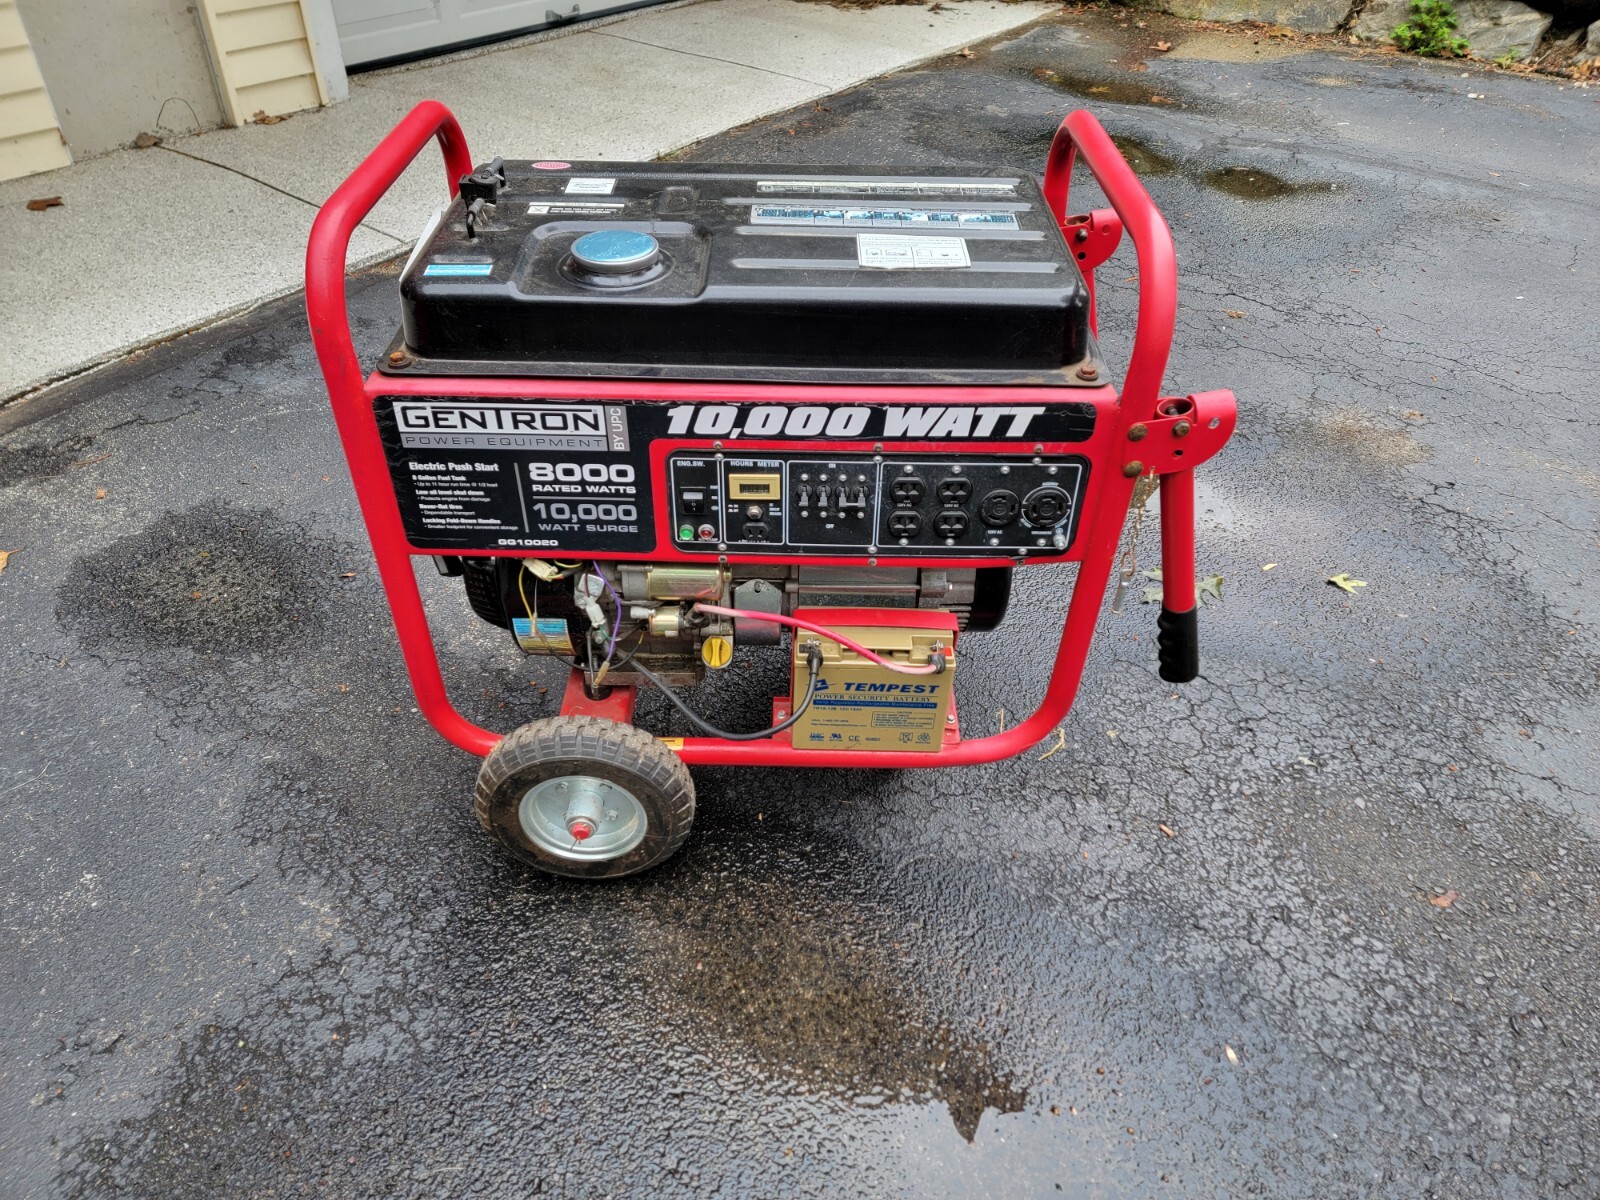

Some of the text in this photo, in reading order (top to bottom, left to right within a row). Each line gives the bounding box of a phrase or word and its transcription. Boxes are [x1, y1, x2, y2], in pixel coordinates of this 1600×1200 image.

[401, 406, 600, 432] GENTRON
[666, 405, 1047, 439] 10,000 WATT
[610, 407, 625, 450] BY UPC
[405, 436, 603, 448] POWER EQUIPMENT
[409, 462, 500, 472] Electric Push Start
[528, 462, 636, 482] 8000
[532, 484, 637, 494] RATED WATTS
[532, 503, 638, 522] 10,000
[538, 523, 639, 533] WATT SURGE
[844, 682, 940, 694] TEMPEST
